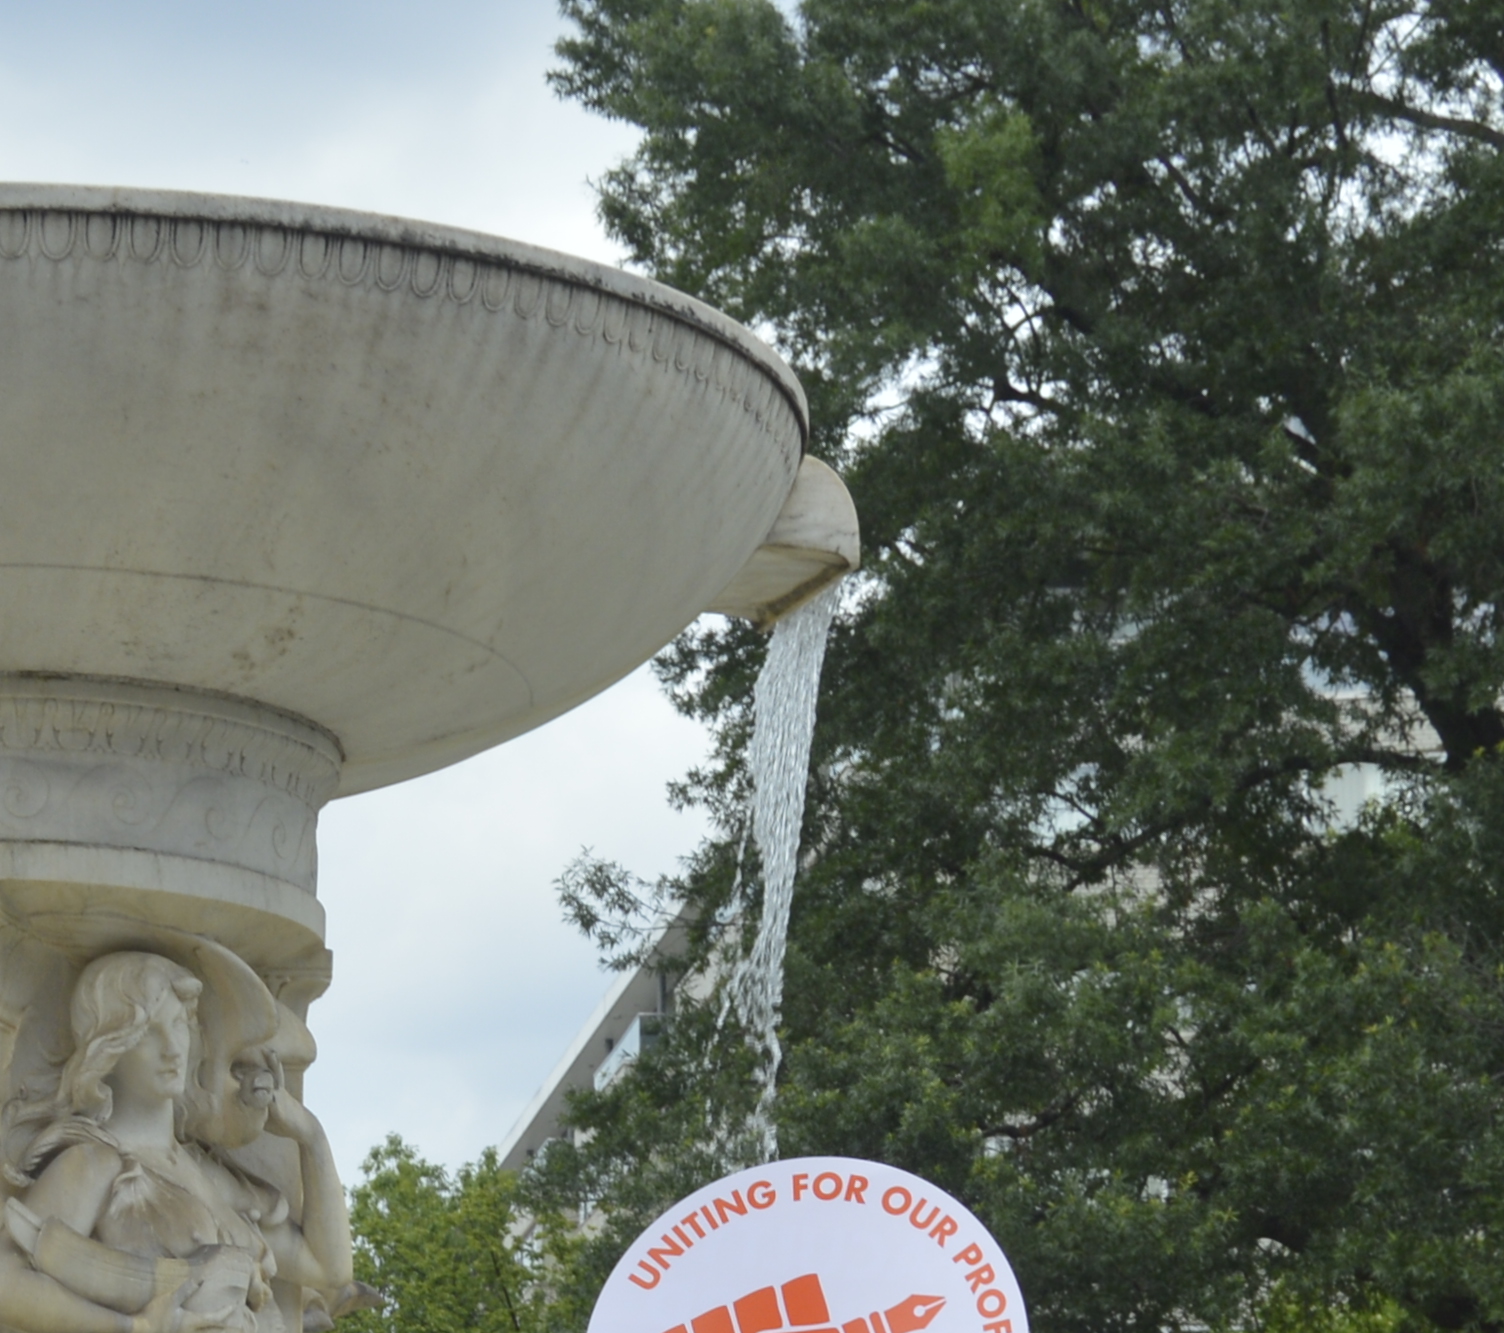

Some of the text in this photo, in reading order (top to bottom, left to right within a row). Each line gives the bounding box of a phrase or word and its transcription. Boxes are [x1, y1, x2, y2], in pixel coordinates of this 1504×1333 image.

[628, 1180, 777, 1290] UNITING
[792, 1171, 869, 1204] FOR
[881, 1185, 959, 1248] OUR
